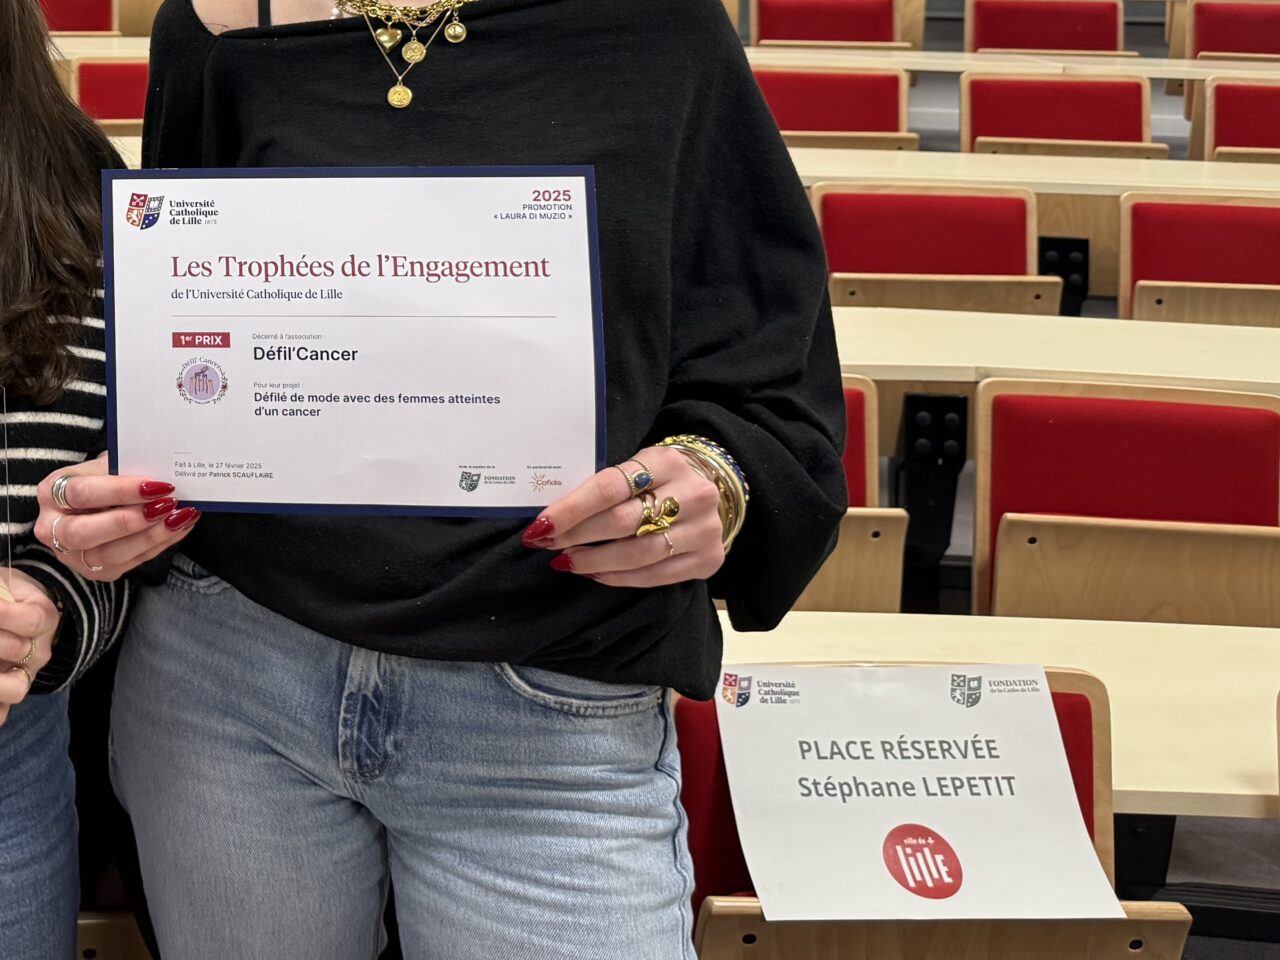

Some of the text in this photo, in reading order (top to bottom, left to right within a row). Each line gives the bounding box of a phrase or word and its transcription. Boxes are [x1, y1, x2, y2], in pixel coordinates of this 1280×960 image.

[532, 190, 572, 202] 2025
[169, 200, 215, 208] Université
[522, 203, 572, 211] PROMOTION
[169, 208, 219, 217] Catholique
[500, 212, 527, 220] LAURA
[529, 212, 537, 220] DI
[539, 212, 566, 220] MUZIO
[169, 217, 181, 225] de
[182, 217, 202, 225] Lille
[171, 254, 551, 283] Les Trophées de l'Engagement
[171, 289, 343, 301] de l'Université Catholique de Lille
[180, 335, 223, 345] 1er PRIX
[253, 346, 359, 361] Défil'Cancer
[282, 382, 300, 390] projet
[254, 392, 501, 404] Défilé de mode avec des femmes atteintes
[254, 406, 321, 416] d'un cancer
[758, 688, 800, 698] Catholique
[770, 696, 787, 704] Lille
[798, 734, 1000, 760] PLACE RÉSERVÉE
[798, 776, 1015, 803] Stéphane LEPETIT
